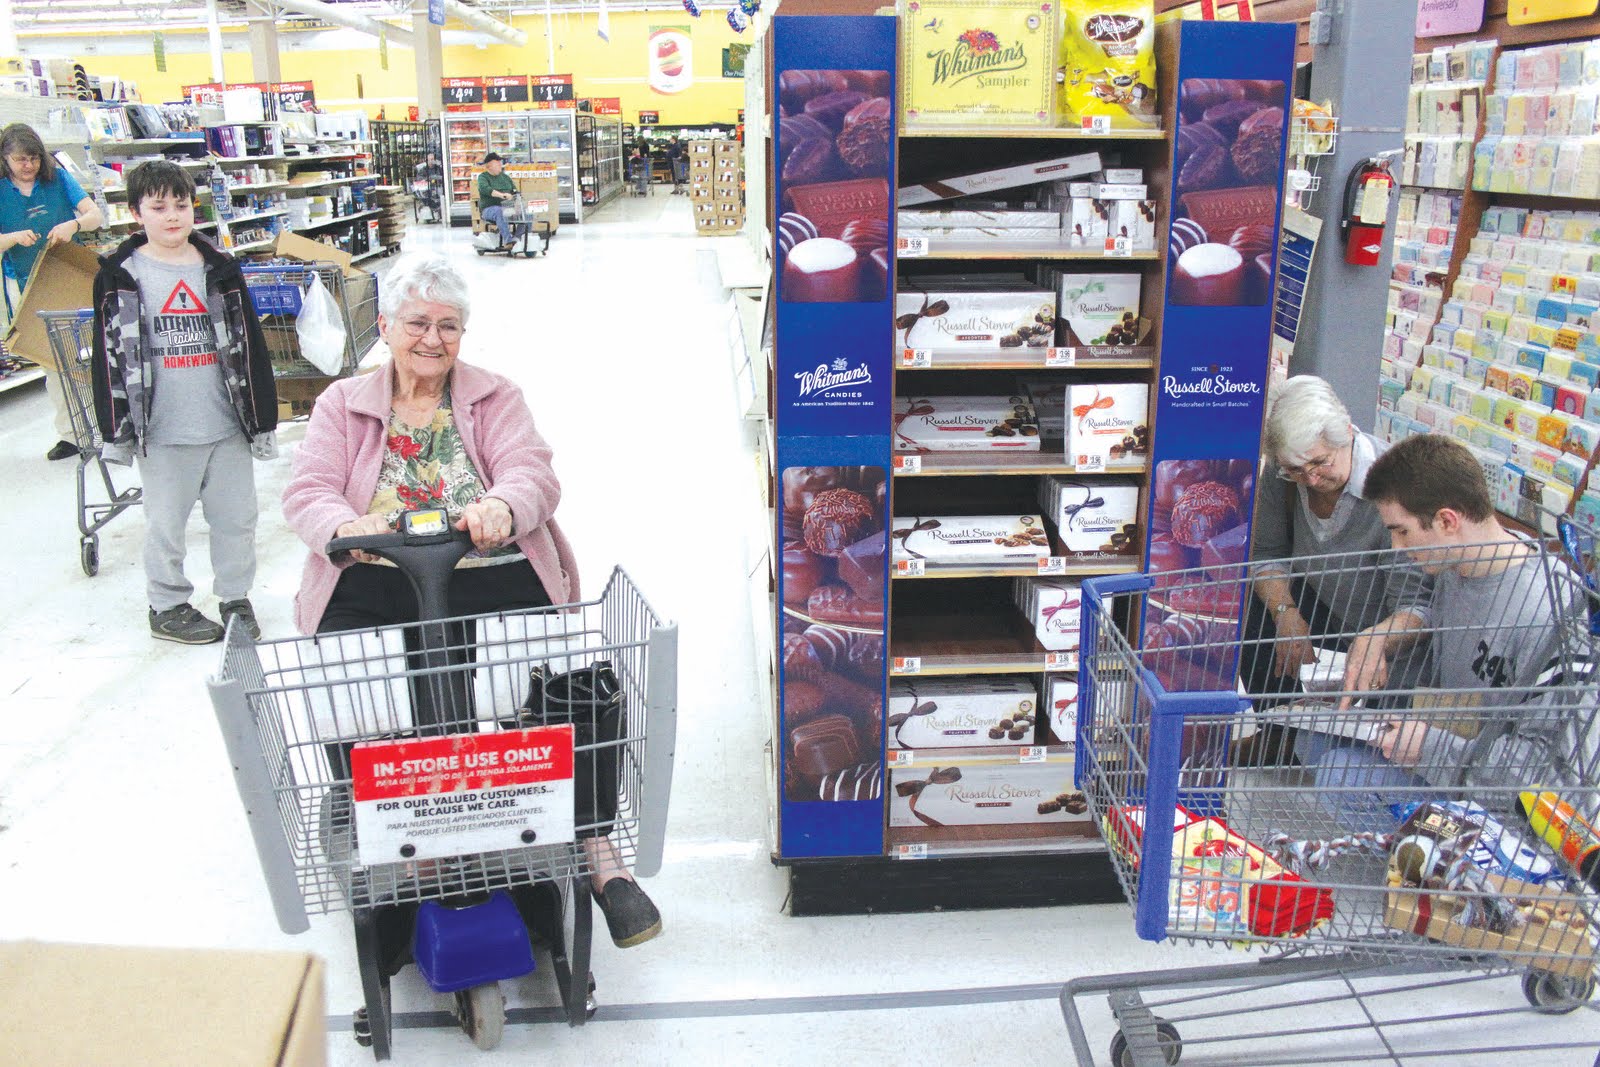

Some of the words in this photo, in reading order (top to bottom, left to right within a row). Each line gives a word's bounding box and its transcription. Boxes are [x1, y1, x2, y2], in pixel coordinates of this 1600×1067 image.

[926, 40, 1027, 87] Whitman's
[976, 75, 1030, 89] Sampler
[1077, 302, 1104, 314] Russell
[1103, 303, 1125, 313] Stover
[933, 317, 976, 335] Russell
[978, 315, 1015, 332] Stover
[160, 327, 208, 345] Teachers
[150, 347, 164, 356] THIS
[167, 346, 180, 355] KID
[182, 345, 201, 355] OFTEN
[163, 352, 219, 369] HOMEWORK
[794, 362, 872, 398] Whitman's
[1162, 375, 1213, 398] Russell
[1213, 374, 1260, 395] Stover
[920, 415, 962, 428] Russell
[964, 415, 1000, 426] Stover
[1085, 418, 1112, 429] Russell
[1112, 417, 1134, 427] Stover
[1075, 517, 1102, 528] Russell
[1102, 516, 1123, 525] Stover
[927, 529, 969, 542] Russell
[972, 528, 1009, 539] Stover
[1052, 618, 1077, 629] Russell
[922, 714, 962, 731] Russell
[963, 713, 998, 728] Stover
[373, 755, 460, 778] IN-STORE
[464, 751, 499, 768] USE
[503, 745, 553, 764] ONLY
[375, 778, 398, 788] PARA
[476, 768, 505, 777] TIENDA
[506, 762, 553, 774] SOLAMENTE
[376, 801, 400, 812] FOR
[403, 798, 429, 809] OUR
[433, 793, 477, 805] VALUED
[945, 784, 997, 804] Russell
[998, 784, 1041, 800] Stover
[414, 804, 464, 818] BECAUSE
[467, 802, 484, 812] WE
[487, 799, 519, 810] CARE.
[386, 822, 408, 831] PARA
[409, 816, 450, 828] NUESTROS
[452, 810, 506, 823] APPRECIADOS
[405, 827, 441, 837] PORQUE
[441, 823, 467, 833] USTED
